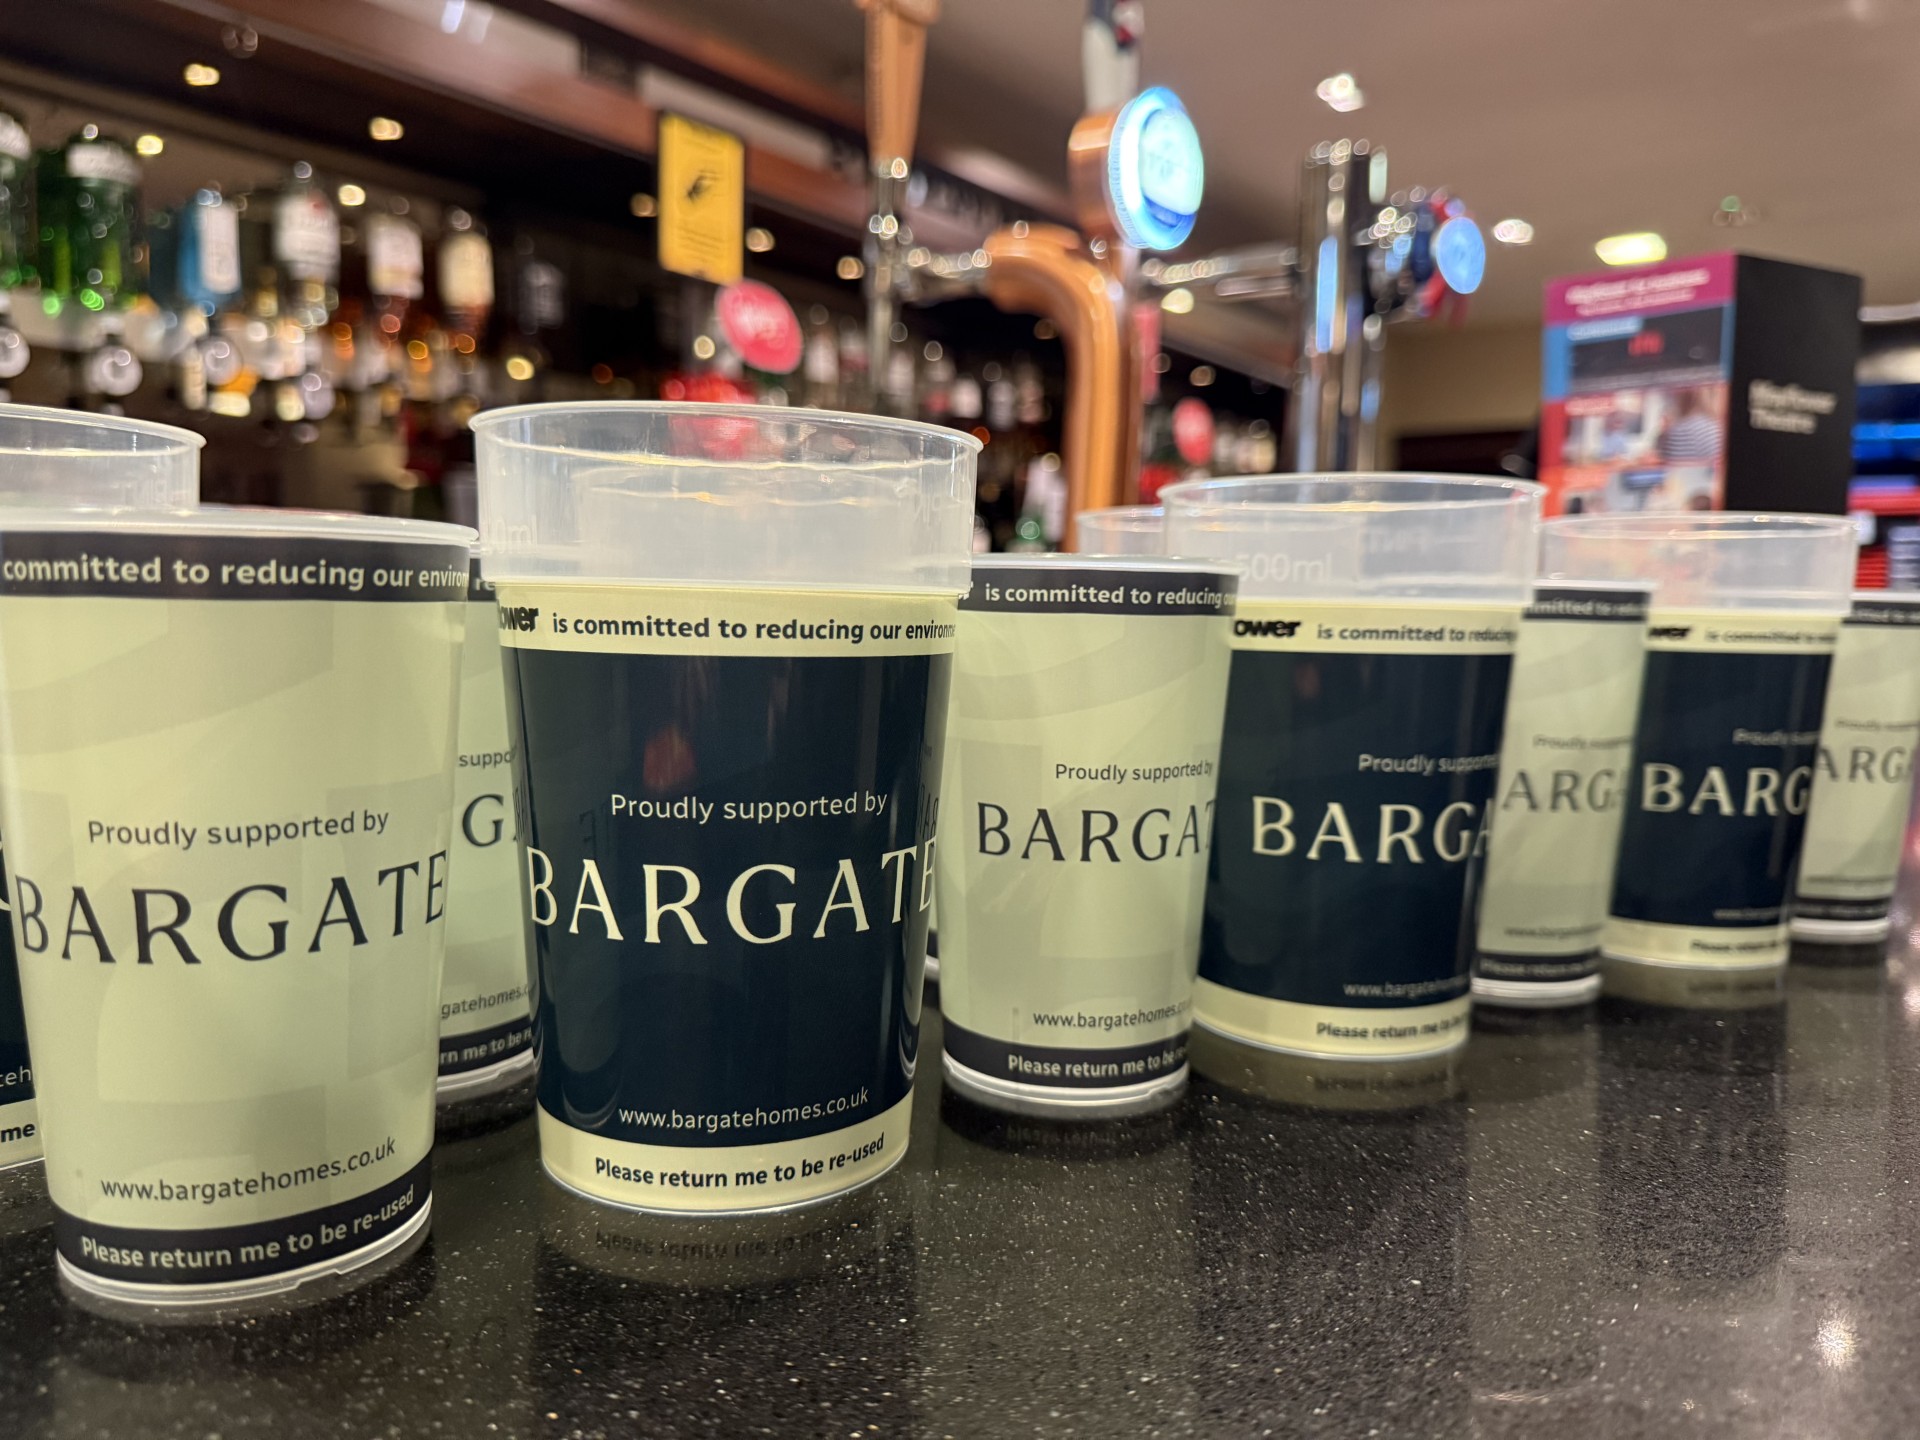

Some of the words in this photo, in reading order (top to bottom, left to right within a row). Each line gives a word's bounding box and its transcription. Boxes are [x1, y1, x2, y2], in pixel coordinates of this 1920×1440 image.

[3, 553, 162, 584] committed
[172, 559, 211, 584] to
[221, 559, 366, 592] reducing
[372, 568, 414, 588] our
[985, 583, 1001, 601] is
[1005, 584, 1124, 604] committed
[1129, 588, 1152, 605] to
[1156, 587, 1222, 609] reducing
[553, 612, 569, 634] is
[573, 615, 711, 638] committed
[718, 620, 748, 640] to
[755, 618, 864, 645] reducing
[870, 623, 902, 640] our
[1317, 624, 1333, 640] is
[1338, 625, 1444, 642] committed
[1449, 626, 1465, 642] to
[1055, 763, 1127, 785] Proudly
[1131, 760, 1202, 783] supported
[1358, 753, 1435, 777] Proudly
[611, 793, 714, 825] Proudly
[723, 791, 859, 824] supported
[864, 790, 888, 816] by
[88, 819, 197, 850] Proudly
[207, 810, 356, 848] supported
[363, 809, 390, 834] by
[527, 834, 937, 945] BARGATE
[15, 850, 447, 965] BARGATE
[1316, 1021, 1370, 1039] Please
[1373, 1025, 1418, 1040] return
[463, 1045, 488, 1062] me
[491, 1038, 506, 1054] to
[1008, 1053, 1062, 1076] Please
[1065, 1060, 1119, 1078] return
[1122, 1058, 1145, 1075] me
[1148, 1055, 1161, 1072] to
[618, 1086, 870, 1134] www.bargatehomes.co.uk
[0, 1123, 36, 1143] me
[100, 1136, 397, 1205] www.bargatehomes.co.uk
[595, 1157, 655, 1186] Please
[659, 1165, 728, 1189] return
[735, 1166, 768, 1187] me
[773, 1161, 797, 1183] to
[801, 1155, 825, 1178] be
[829, 1132, 885, 1171] re-used
[81, 1235, 145, 1268] Please
[149, 1243, 233, 1270] return
[239, 1240, 282, 1266] me
[286, 1233, 314, 1256] to
[320, 1223, 349, 1247] be
[352, 1184, 415, 1237] re-used
